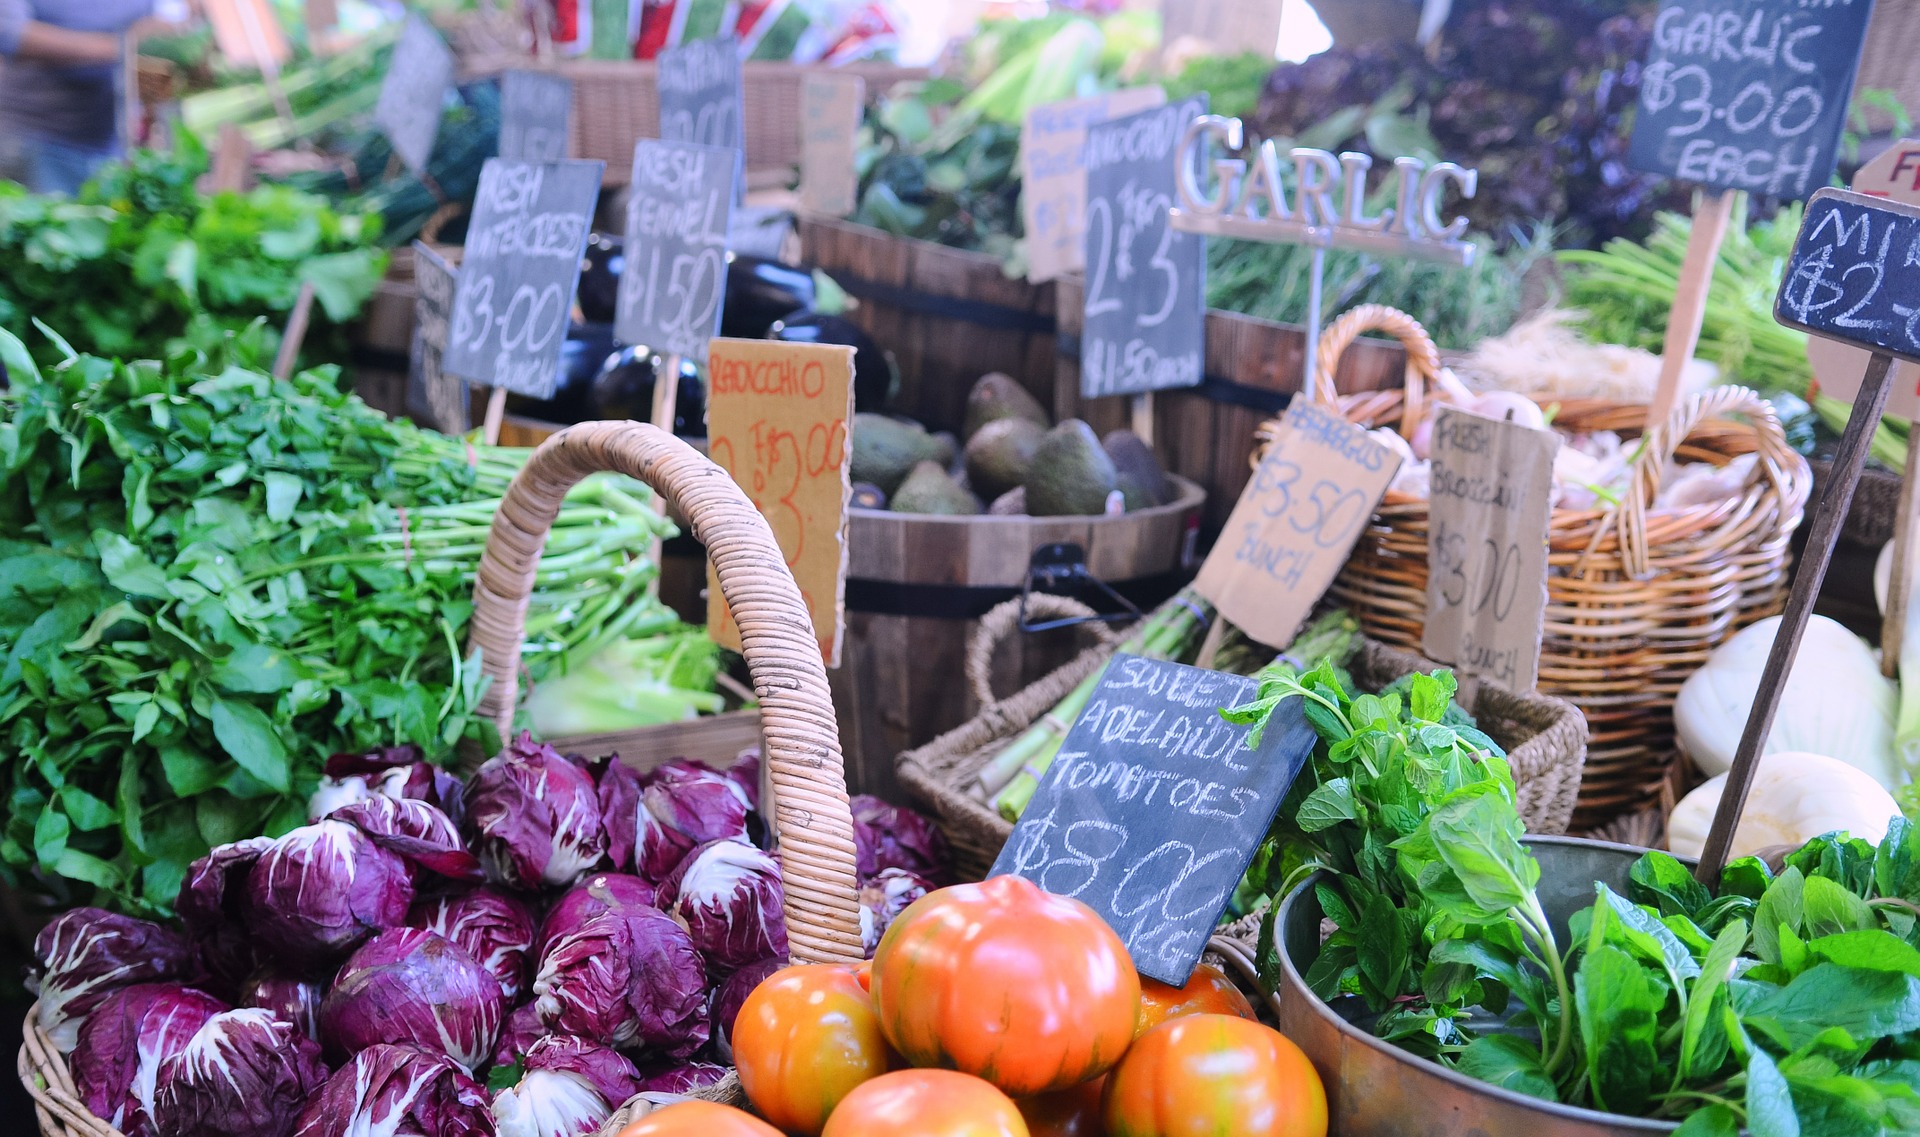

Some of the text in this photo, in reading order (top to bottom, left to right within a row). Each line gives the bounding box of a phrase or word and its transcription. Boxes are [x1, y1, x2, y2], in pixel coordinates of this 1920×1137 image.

[1641, 57, 1823, 138] $3.00
[1174, 114, 1478, 242] GARLIC
[1676, 139, 1819, 195] EACH
[1104, 657, 1259, 711] SWEET
[1048, 751, 1261, 820] TOMATOES
